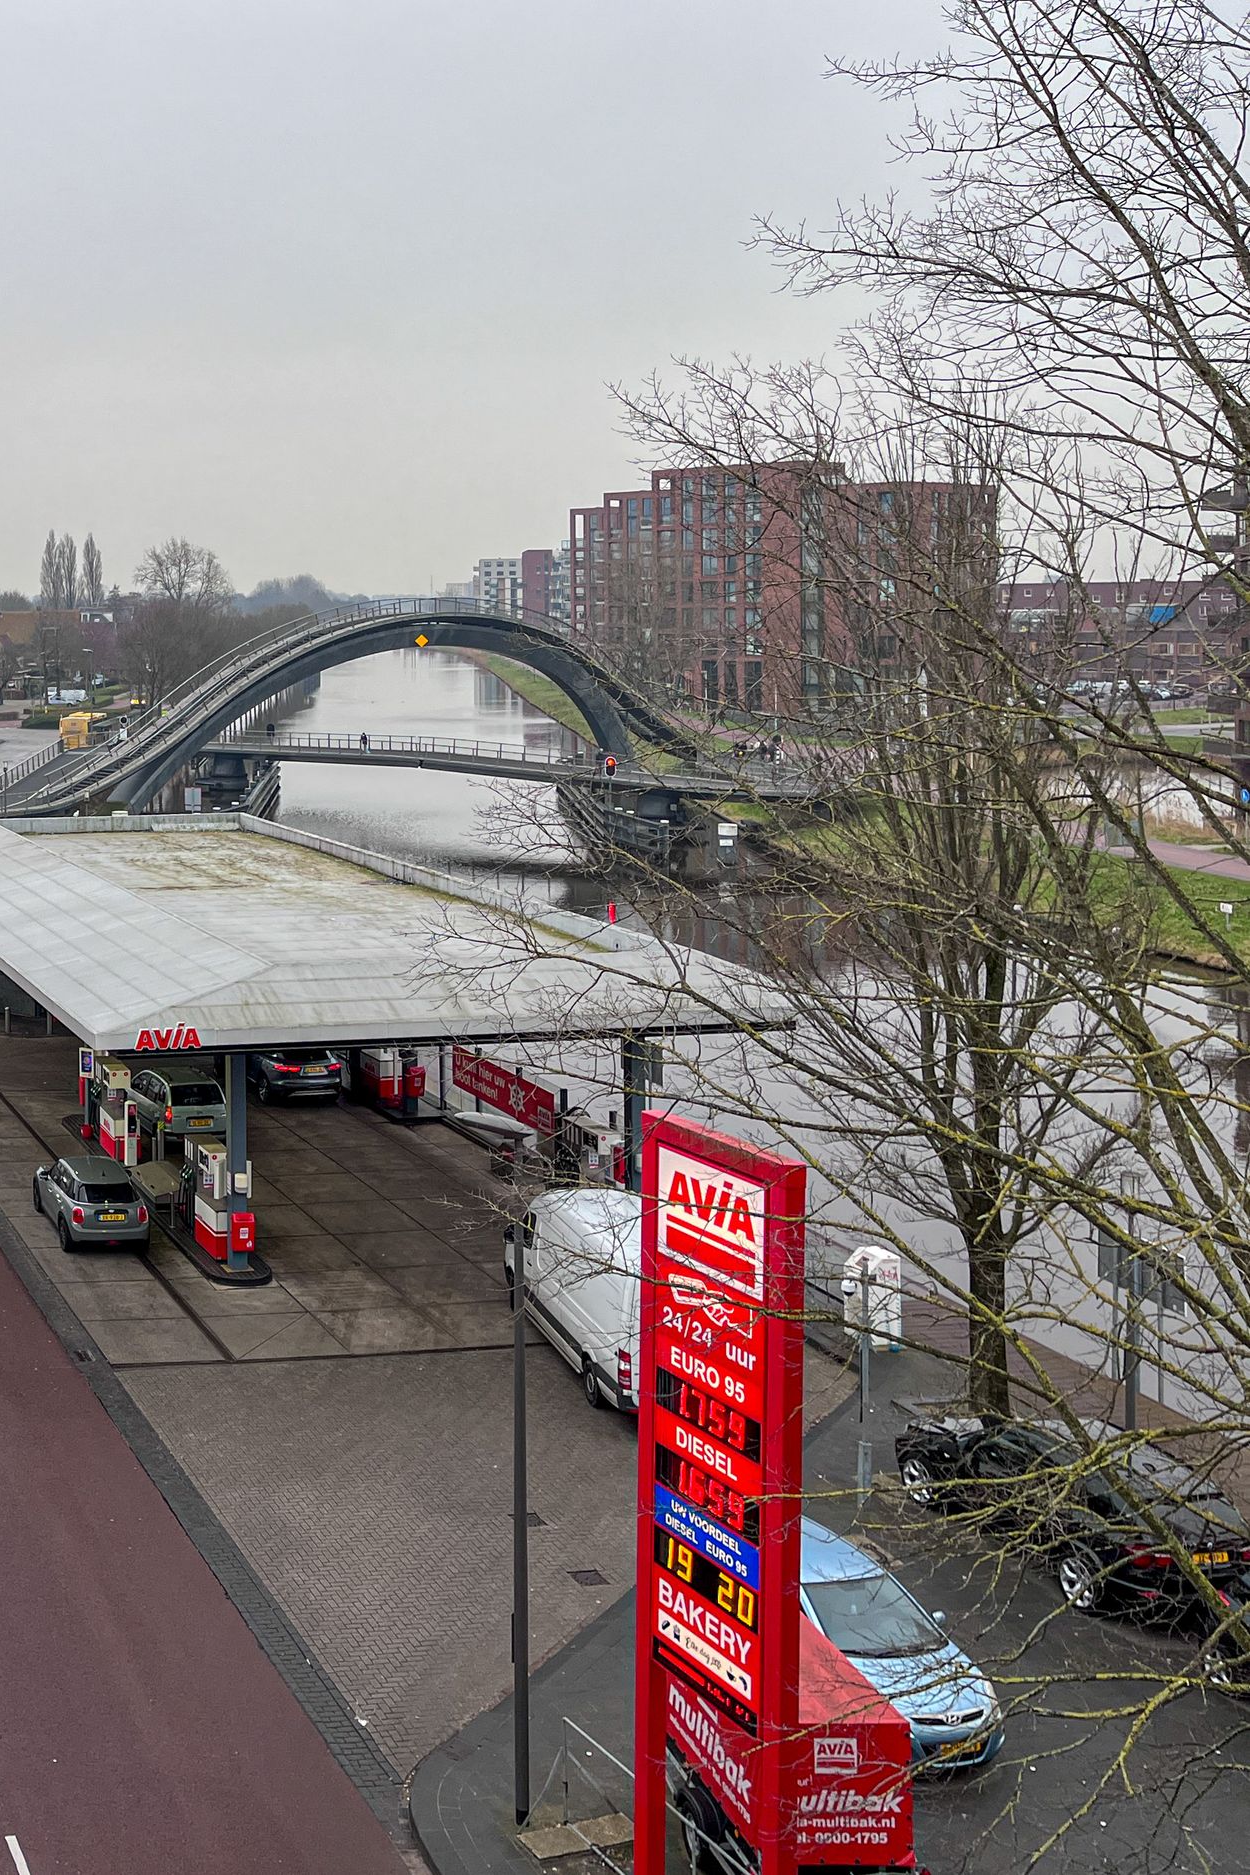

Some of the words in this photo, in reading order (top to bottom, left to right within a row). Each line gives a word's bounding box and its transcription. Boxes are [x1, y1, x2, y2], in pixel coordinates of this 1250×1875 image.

[135, 1022, 202, 1051] AVIA
[473, 1077, 498, 1101] tanken!
[479, 1064, 492, 1081] hier
[494, 1075, 505, 1088] uw
[667, 1170, 756, 1245] AVIA
[662, 1305, 712, 1347] 24/24
[725, 1342, 756, 1371] uur
[671, 1345, 720, 1388] EURO
[724, 1376, 745, 1403] 95
[676, 1426, 738, 1481] DIESEL
[665, 1513, 698, 1545] DIESEL
[705, 1540, 734, 1568] EURO
[735, 1561, 748, 1577] 95
[671, 1499, 687, 1518] UW
[689, 1510, 742, 1556] VOORDEEL
[667, 1538, 694, 1583] 19
[717, 1571, 754, 1627] 20
[659, 1577, 752, 1665] BAKERY
[669, 1683, 751, 1806] multibak
[816, 1740, 855, 1756] AVIA
[797, 1789, 904, 1814] ultibak
